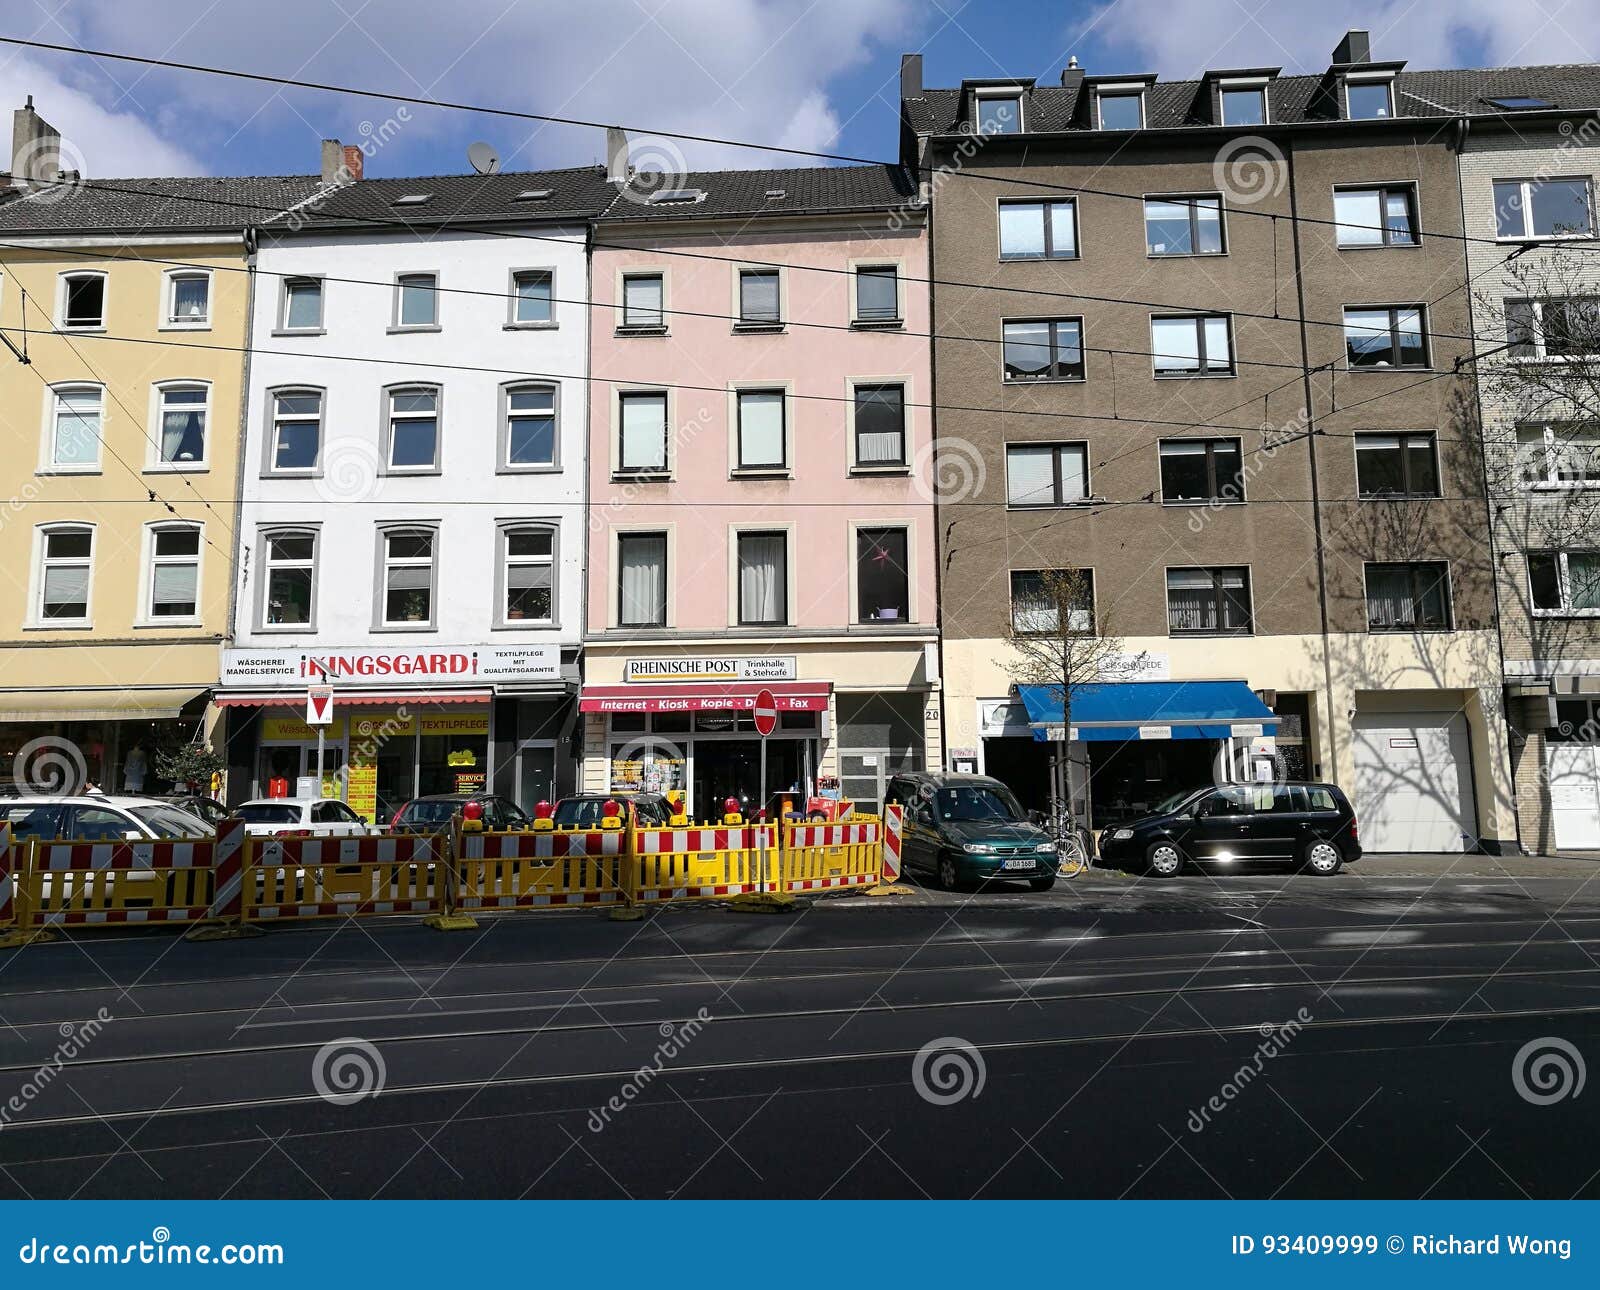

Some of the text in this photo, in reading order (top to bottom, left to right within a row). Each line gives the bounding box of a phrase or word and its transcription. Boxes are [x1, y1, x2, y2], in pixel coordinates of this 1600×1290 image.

[308, 654, 469, 675] KINGSGARD
[631, 660, 738, 674] RHEINISCHE POST
[747, 660, 785, 668] Trinkhalle
[226, 667, 295, 675] MANGELSERVICE
[752, 668, 787, 677] Stehcafé
[601, 701, 647, 710] Internet
[658, 700, 689, 709] Kiosk
[701, 698, 734, 709] Kopie
[790, 698, 808, 708] Fax
[925, 710, 939, 721] 20
[421, 719, 488, 729] TEXTILPFLEGE
